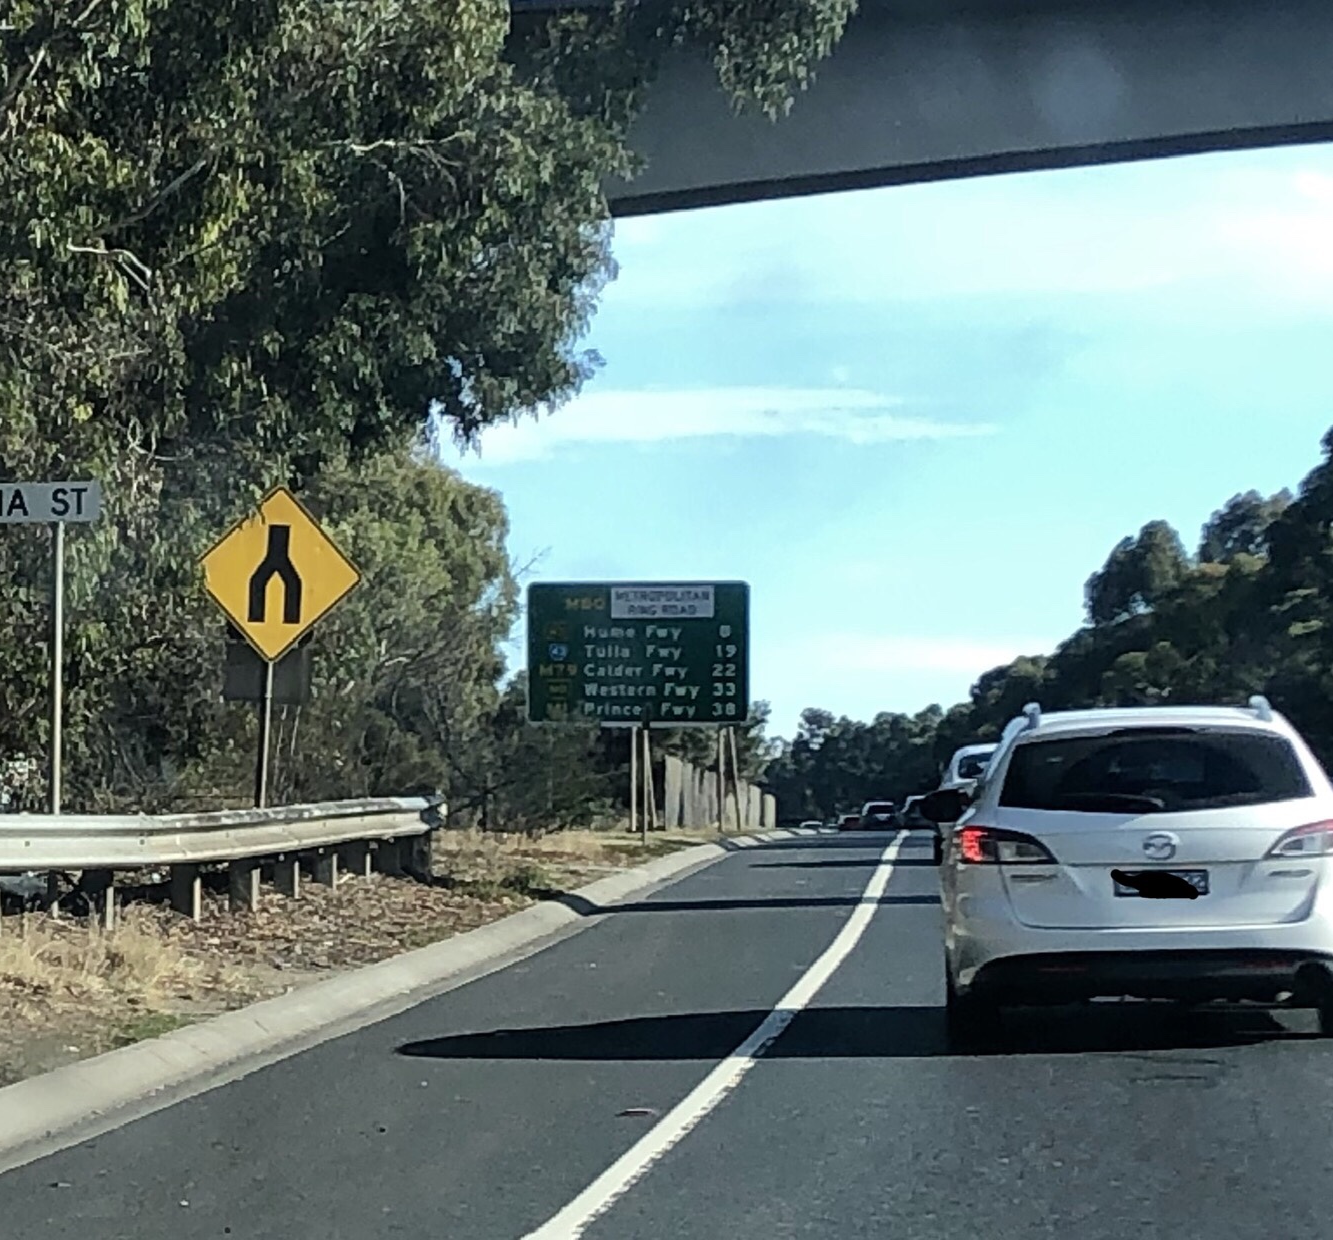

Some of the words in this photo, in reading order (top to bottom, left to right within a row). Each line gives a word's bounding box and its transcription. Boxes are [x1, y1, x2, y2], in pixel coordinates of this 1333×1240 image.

[51, 487, 88, 516] ST
[661, 604, 697, 615] ROAD
[583, 624, 636, 639] Hume
[645, 624, 683, 642] Fwy
[584, 644, 631, 658] Tulla
[645, 644, 683, 661] Fwy
[715, 644, 737, 658] 19
[583, 663, 644, 677] Calder
[652, 663, 689, 680] Fwy
[711, 663, 736, 677] 22
[583, 682, 657, 697] Western
[663, 682, 701, 700] Fwy
[711, 682, 736, 697] 33
[584, 702, 648, 717] Prince
[660, 702, 697, 719] Fwy
[711, 702, 736, 716] 38
